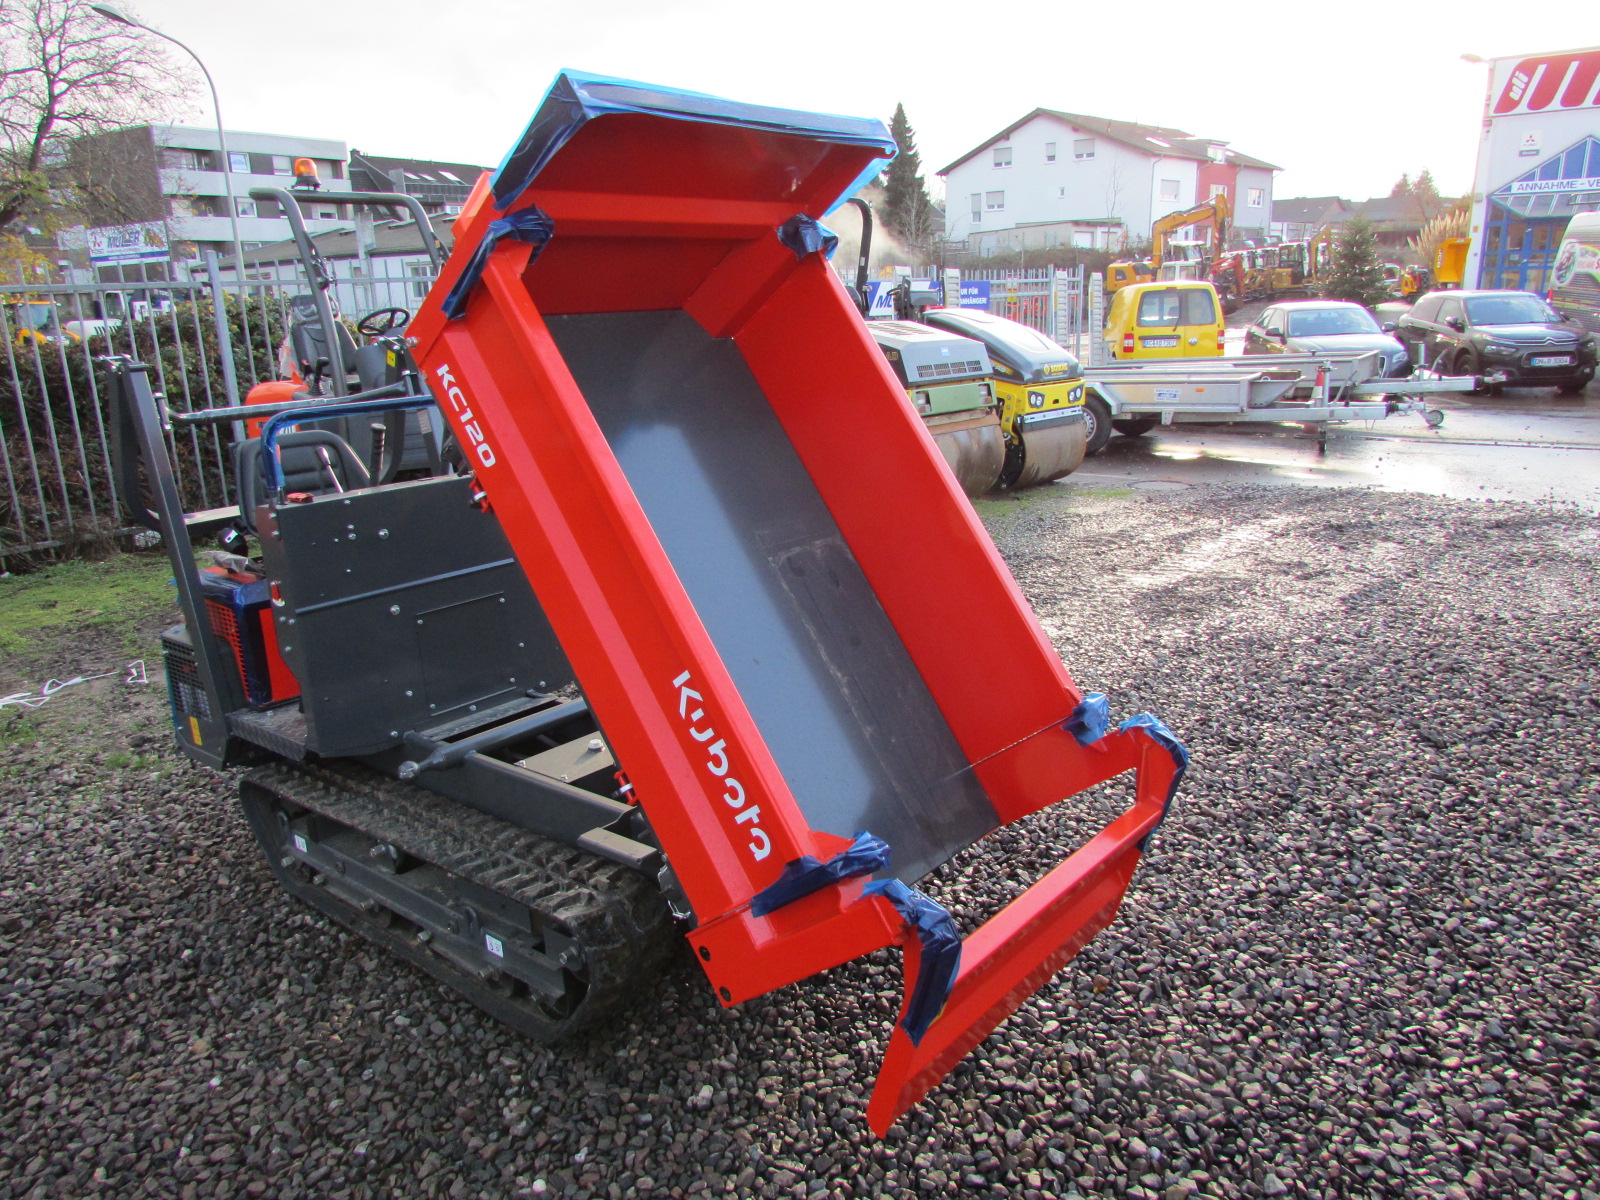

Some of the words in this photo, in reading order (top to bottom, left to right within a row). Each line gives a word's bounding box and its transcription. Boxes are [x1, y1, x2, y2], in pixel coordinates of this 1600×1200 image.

[1517, 180, 1577, 192] ANNAHME
[437, 364, 496, 468] KC120
[672, 669, 771, 862] Kubota
